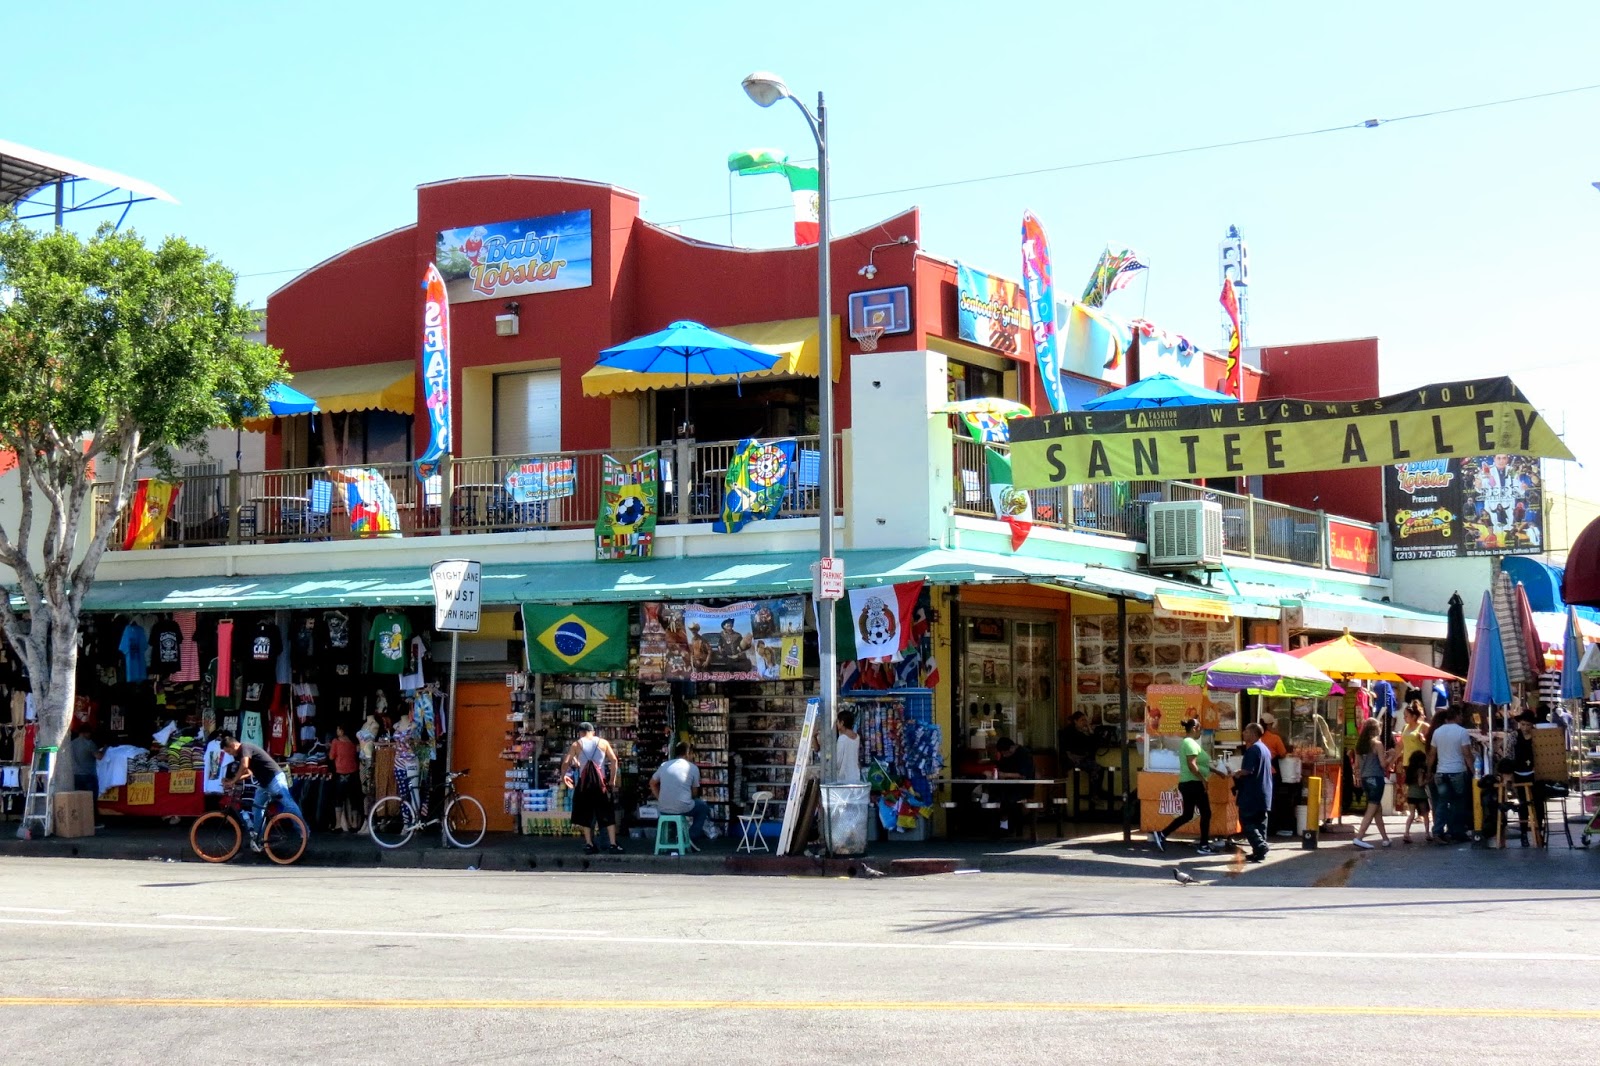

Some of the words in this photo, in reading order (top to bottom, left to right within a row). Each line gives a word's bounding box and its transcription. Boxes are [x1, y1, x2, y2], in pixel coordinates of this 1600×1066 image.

[484, 231, 559, 264] Baby
[469, 258, 567, 296] Lobster
[960, 290, 993, 320] Seafood
[993, 301, 1002, 320] &
[1001, 304, 1019, 328] Grill
[1210, 401, 1384, 423] WELCOMES
[1418, 385, 1475, 405] YOU
[1149, 411, 1178, 419] FASHION
[1043, 415, 1094, 434] THE
[1125, 412, 1149, 428] LA
[1149, 419, 1178, 427] DISTRICT
[1046, 430, 1285, 483] SANTEE
[1341, 409, 1540, 464] ALLEY
[520, 462, 545, 474] NOW
[548, 459, 572, 472] OPEN!
[1399, 472, 1454, 494] Lobster
[1411, 495, 1438, 503] Presenta
[1411, 508, 1434, 518] SHOW
[1396, 551, 1416, 560] (213)
[1418, 550, 1457, 558] 747-0605
[822, 560, 831, 569] NO
[436, 571, 461, 580] RIGHT
[464, 573, 478, 582] LANE
[446, 589, 474, 602] MUST
[440, 609, 457, 619] TURN
[460, 610, 477, 620] RIGHT
[254, 645, 269, 654] CALI
